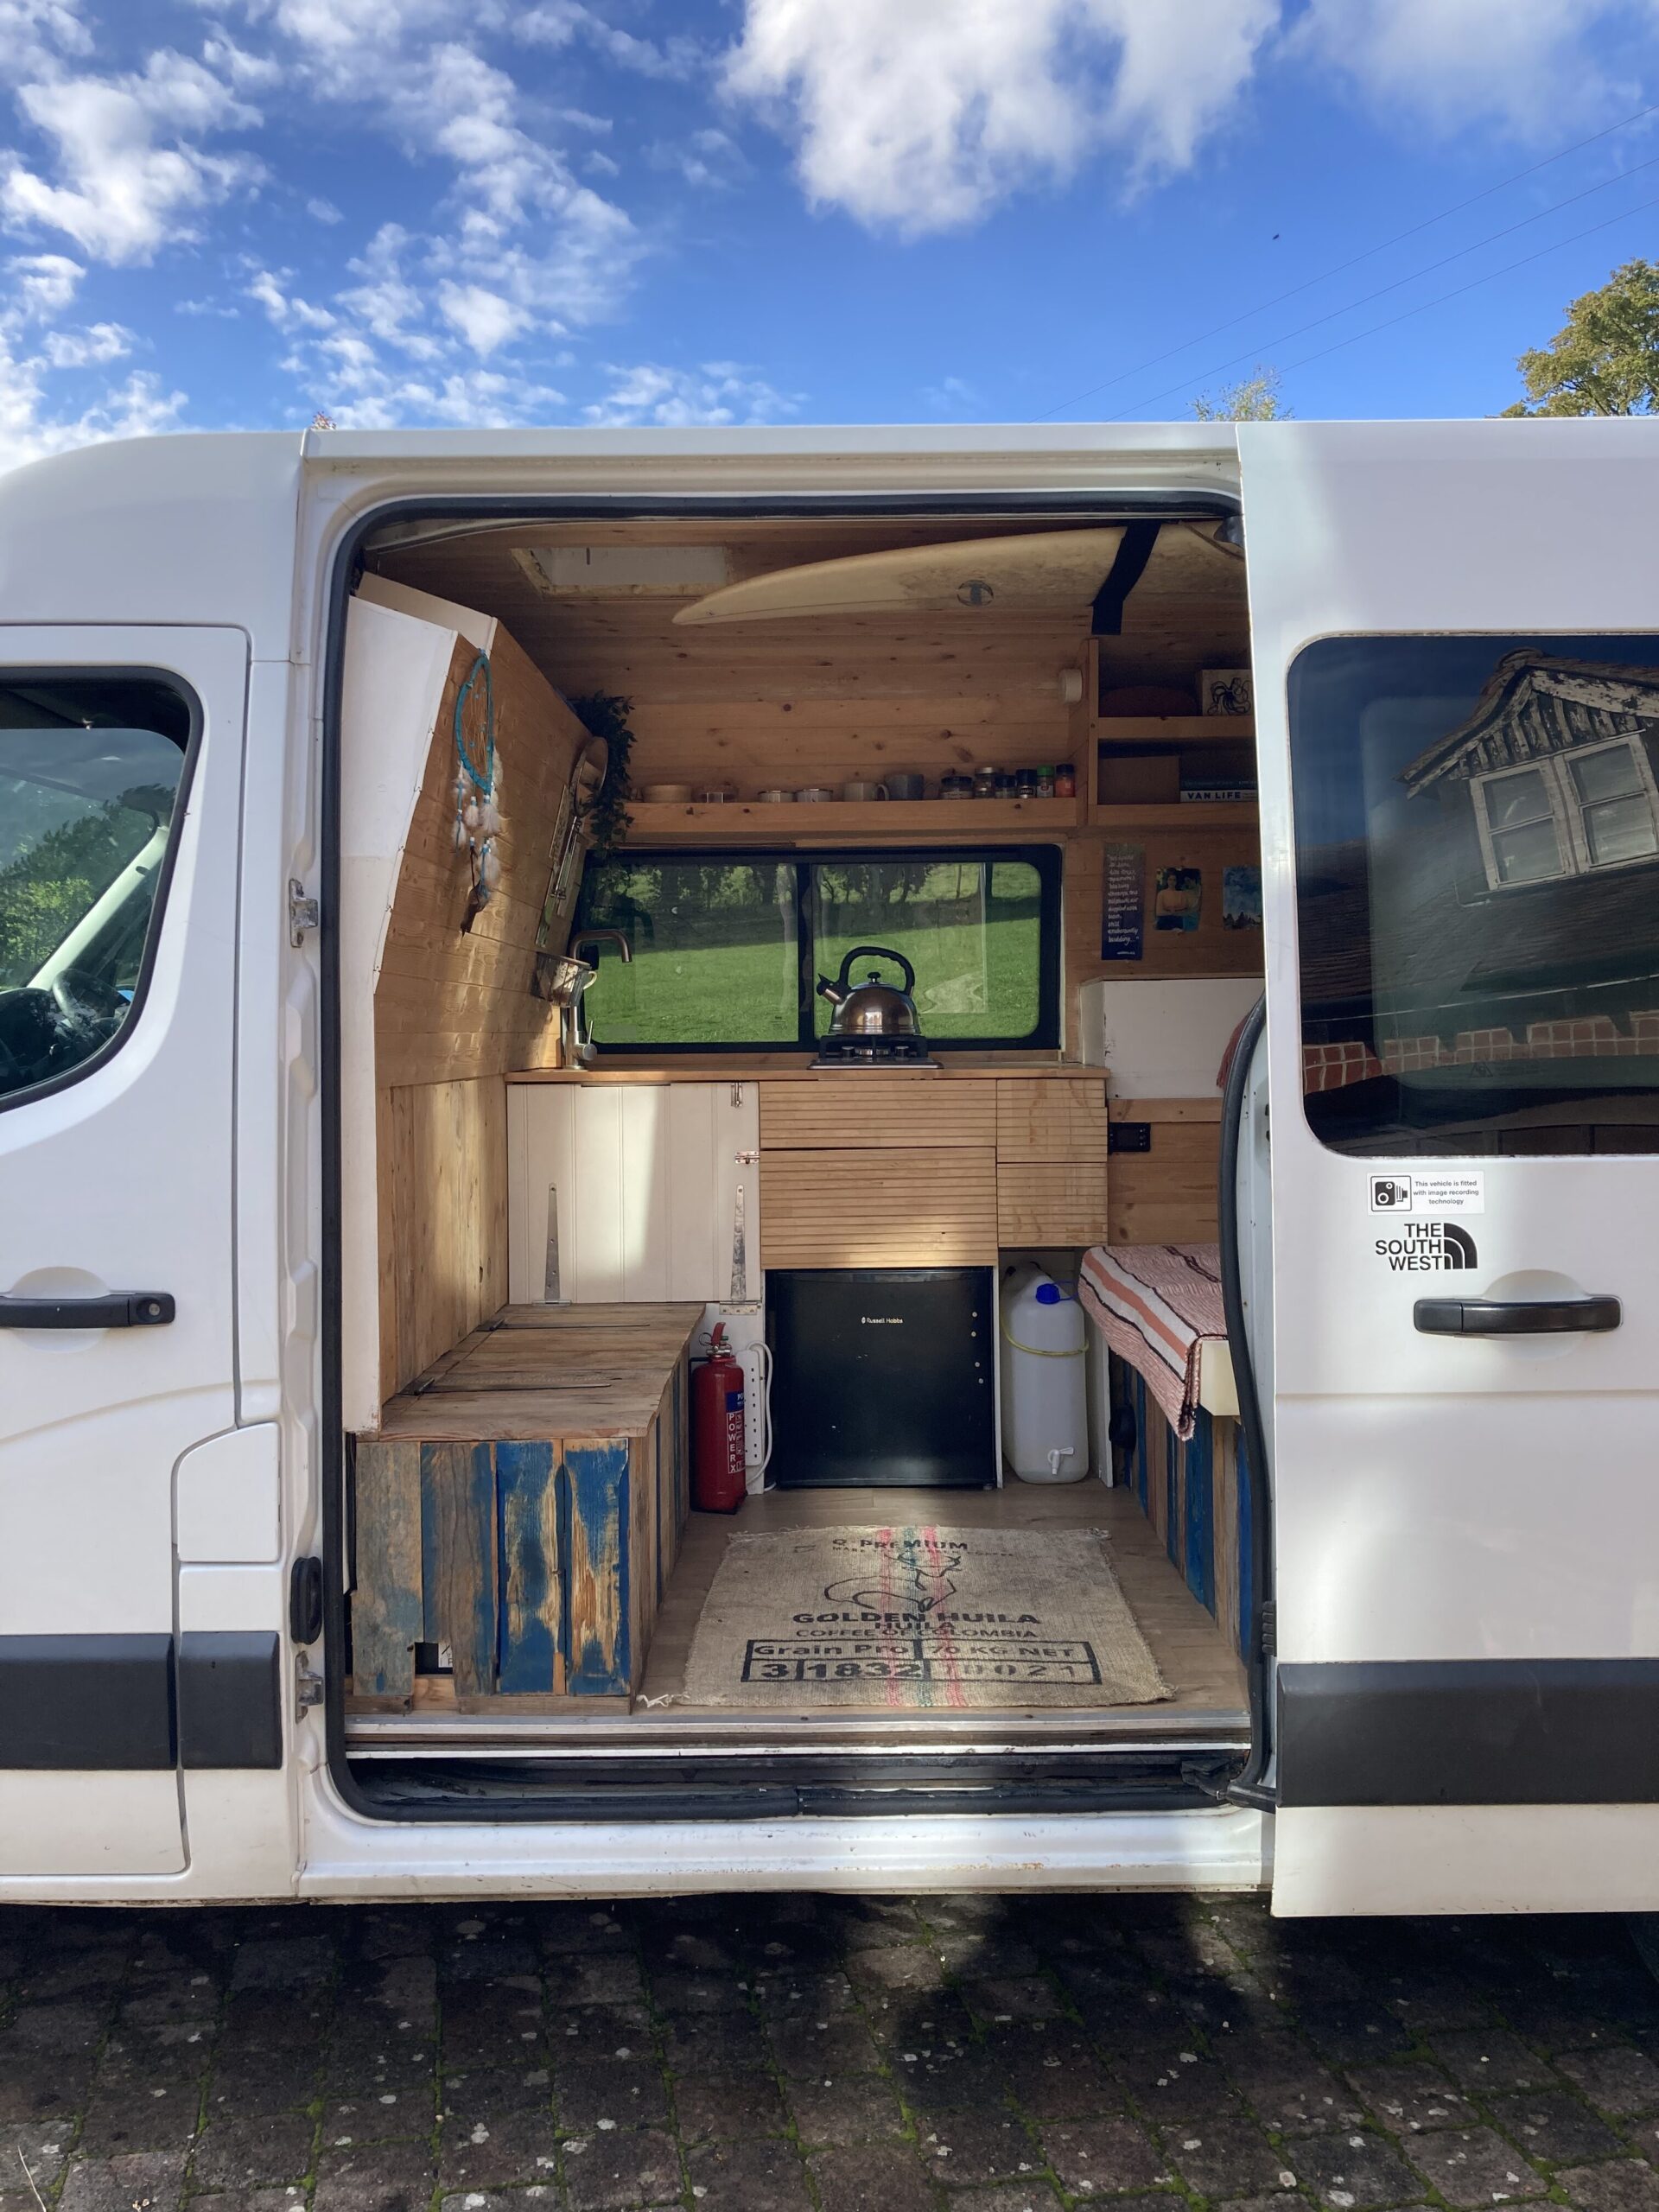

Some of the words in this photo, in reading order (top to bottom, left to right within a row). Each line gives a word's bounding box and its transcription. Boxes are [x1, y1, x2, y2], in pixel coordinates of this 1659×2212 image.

[1404, 1223, 1441, 1237] THE
[1376, 1239, 1441, 1255] SOUTH
[1389, 1255, 1443, 1271] WEST
[860, 1539, 968, 1549] PREMIUM
[792, 1612, 925, 1624] GOLDEN
[938, 1612, 1040, 1624] HUILA
[875, 1622, 956, 1630] HUILA
[918, 1630, 1039, 1638] COLOMBIA
[754, 1645, 842, 1655] Grain
[855, 1644, 909, 1654] Pro
[928, 1645, 960, 1654] 70
[970, 1646, 1009, 1655] KG
[1020, 1647, 1073, 1656] NET
[760, 1663, 790, 1677] 3
[806, 1662, 922, 1678] 1832
